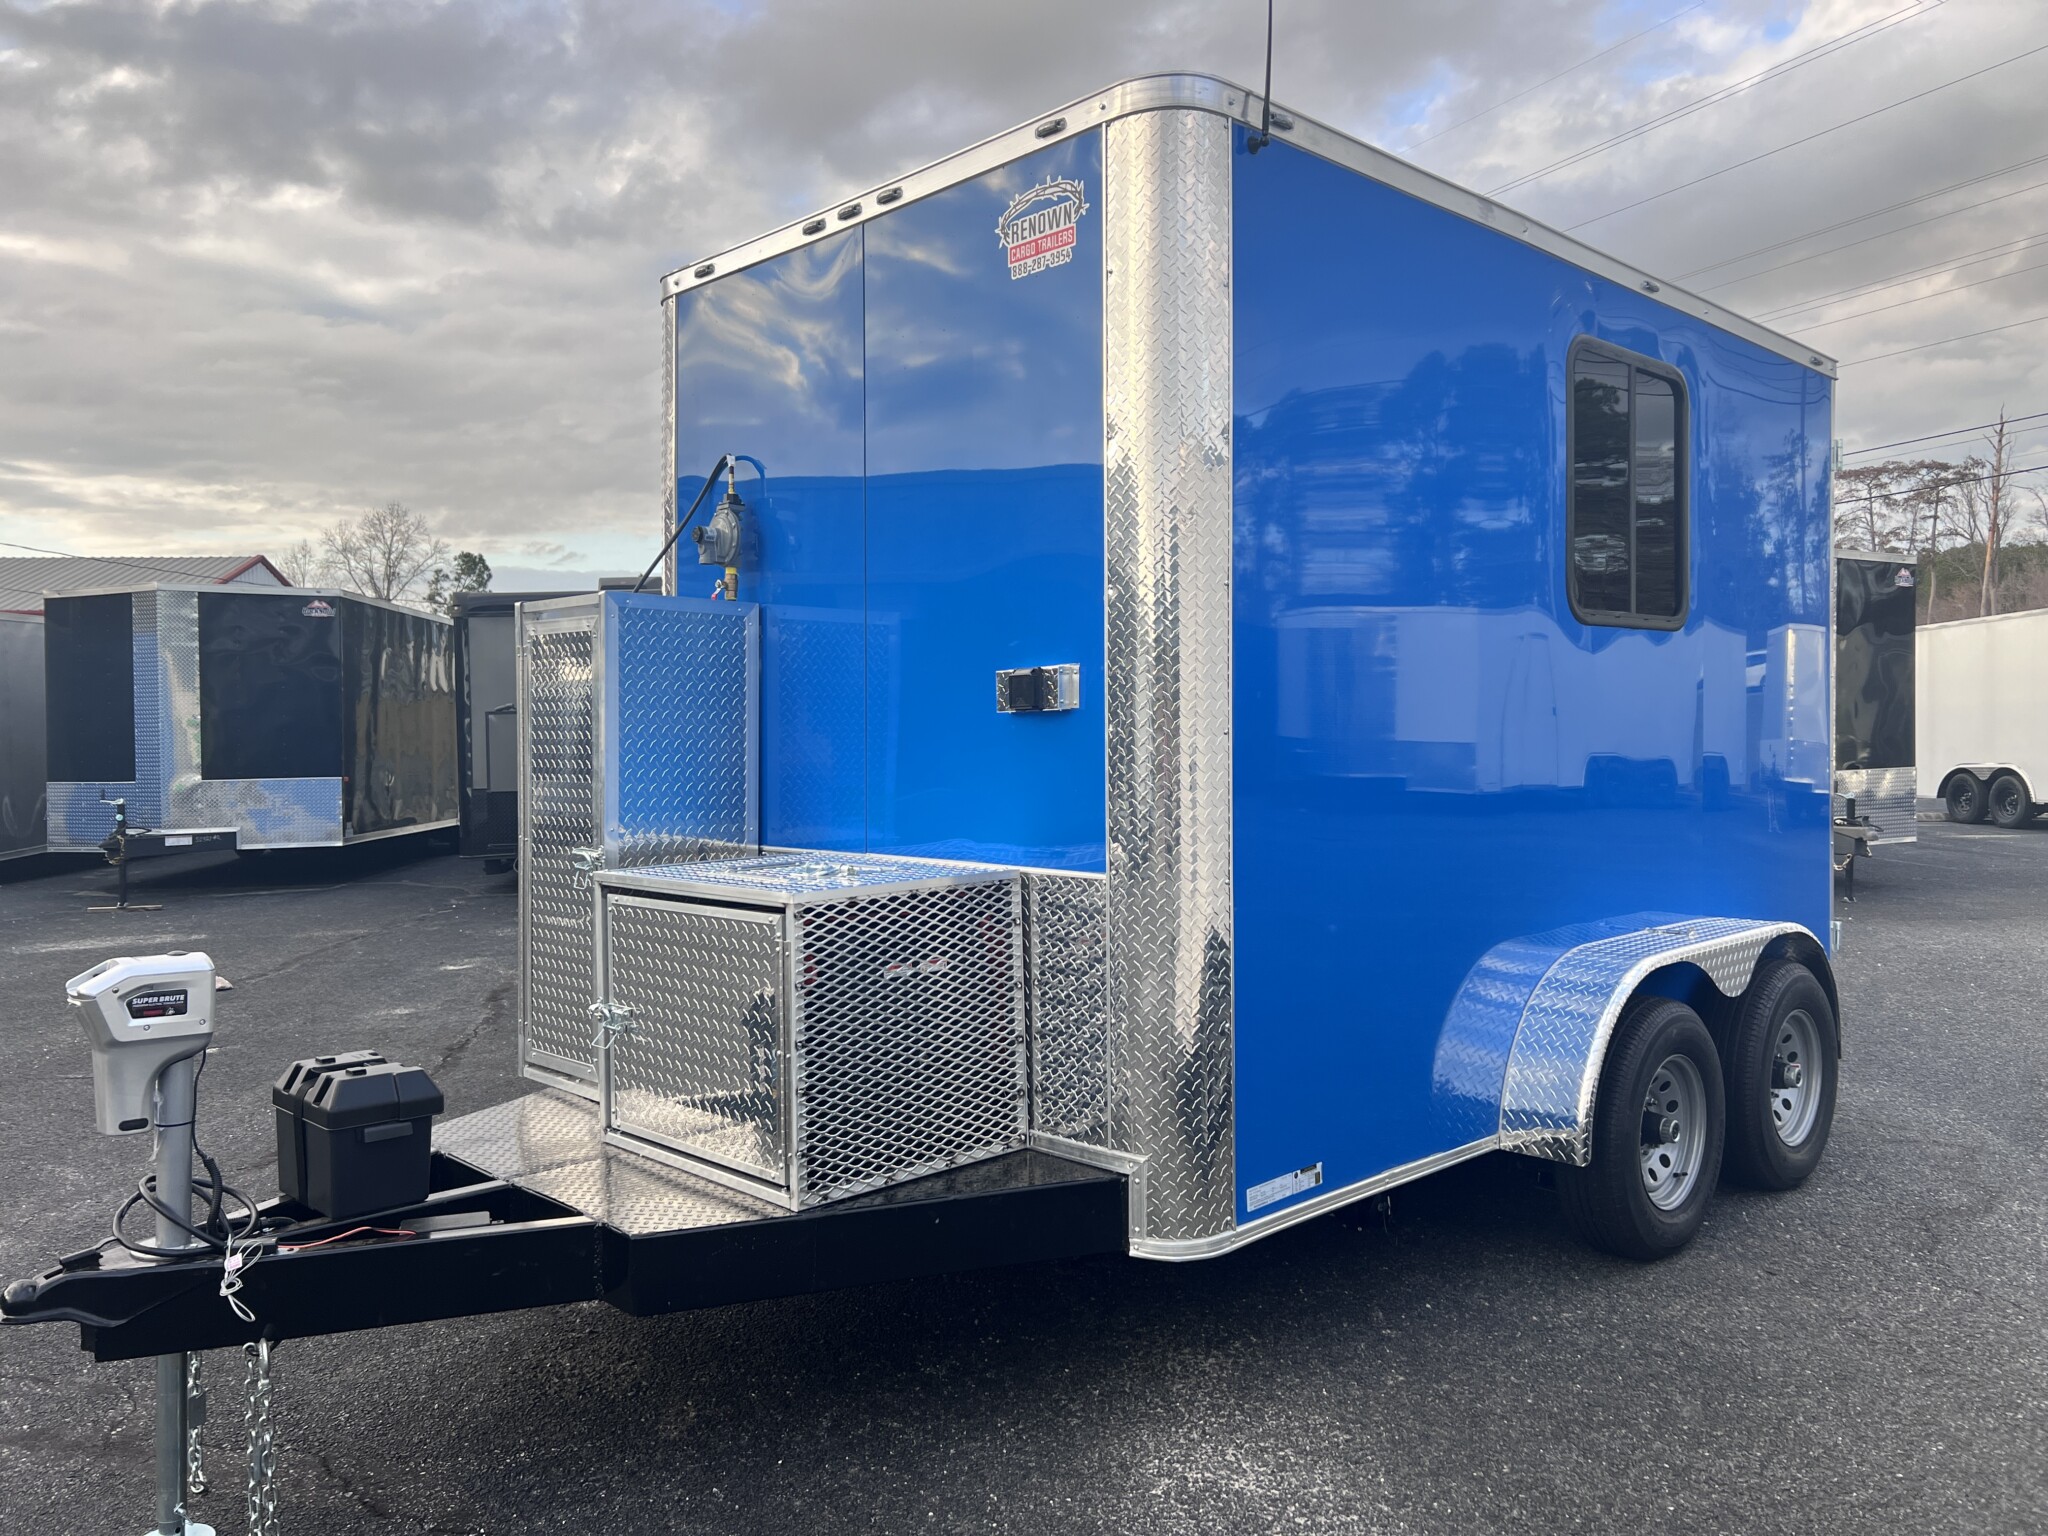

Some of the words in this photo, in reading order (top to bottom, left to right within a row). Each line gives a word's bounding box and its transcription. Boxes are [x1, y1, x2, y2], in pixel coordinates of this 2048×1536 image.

[1011, 202, 1072, 244] RENOWN
[1011, 243, 1036, 261] CARGO
[1038, 230, 1073, 250] TRAILERS
[1012, 248, 1071, 277] 888-287-3954
